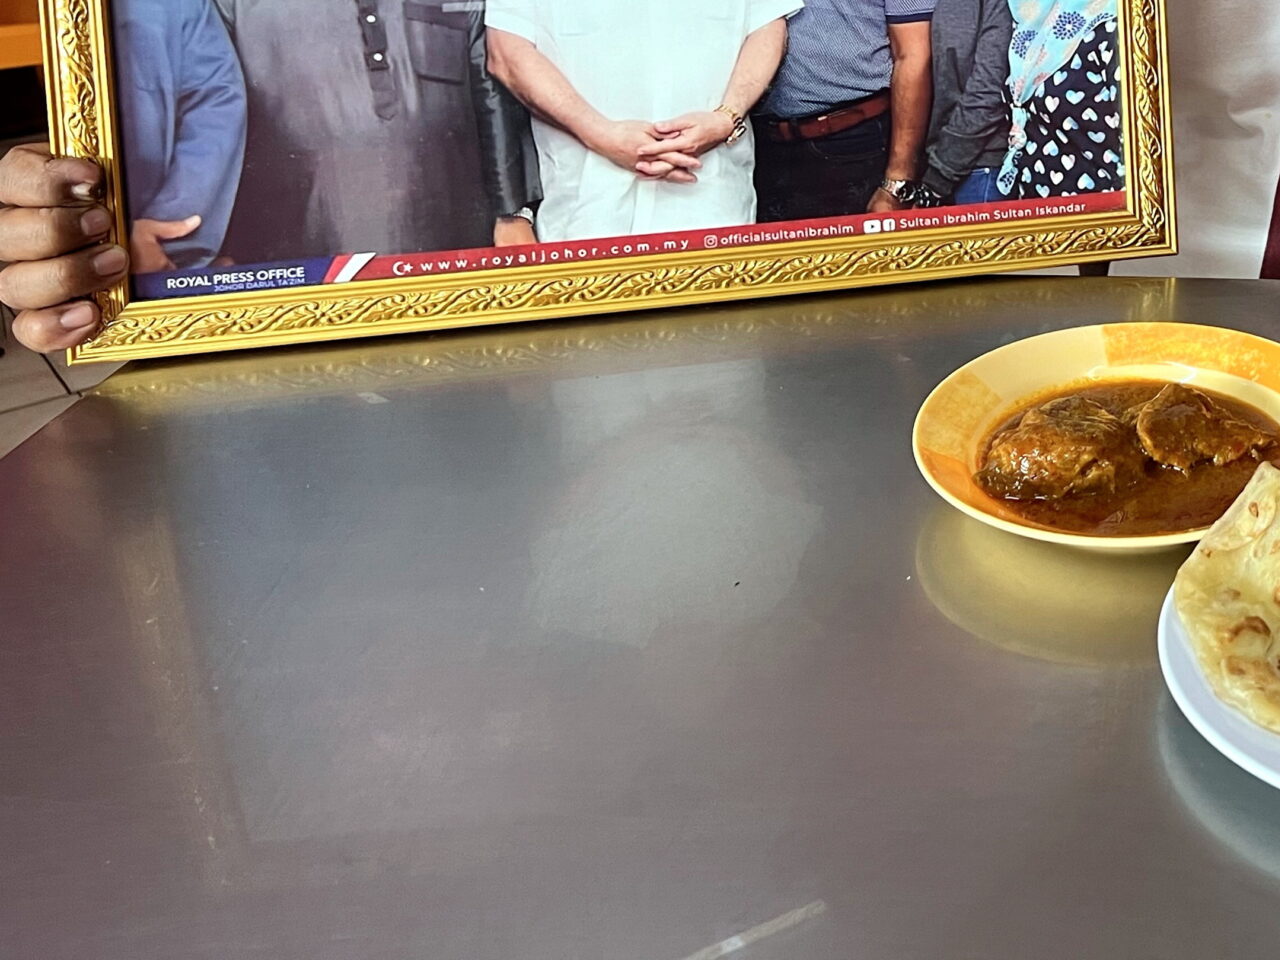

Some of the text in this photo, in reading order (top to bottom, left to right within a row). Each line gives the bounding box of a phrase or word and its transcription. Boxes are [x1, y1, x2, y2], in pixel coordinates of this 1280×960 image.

[720, 224, 854, 246] officialsultanibrahim
[900, 217, 940, 229] Sultan
[943, 210, 990, 224] Ibrahim
[993, 206, 1032, 220] Sultan
[1035, 202, 1086, 216] Iskandar
[166, 266, 305, 289] ROYAL PRESS OFFICE
[213, 283, 245, 292] JOHOR
[246, 280, 275, 290] DARUL
